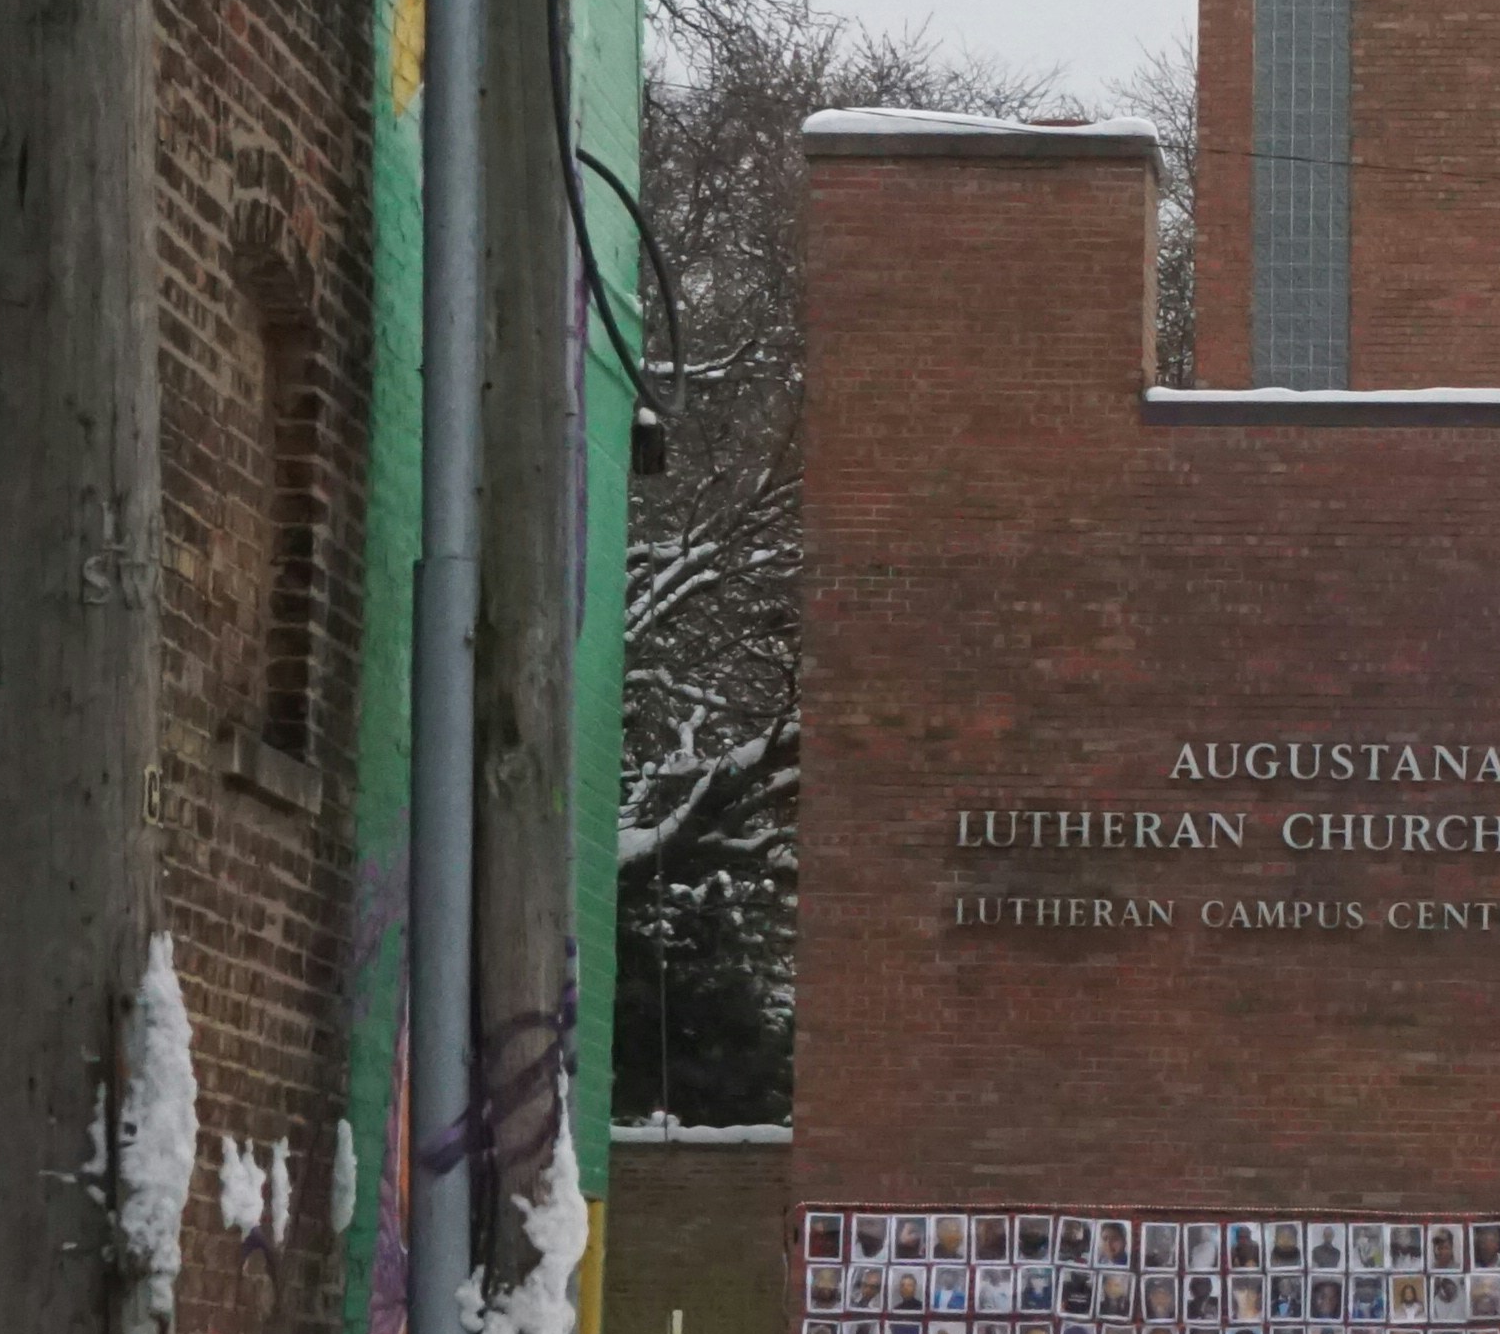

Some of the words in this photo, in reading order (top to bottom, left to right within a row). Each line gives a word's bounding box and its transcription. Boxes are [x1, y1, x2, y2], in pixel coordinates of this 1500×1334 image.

[956, 810, 1247, 849] LUTHERAN
[955, 897, 1175, 928] LUTHERAN
[1201, 899, 1364, 929] CAMPUS
